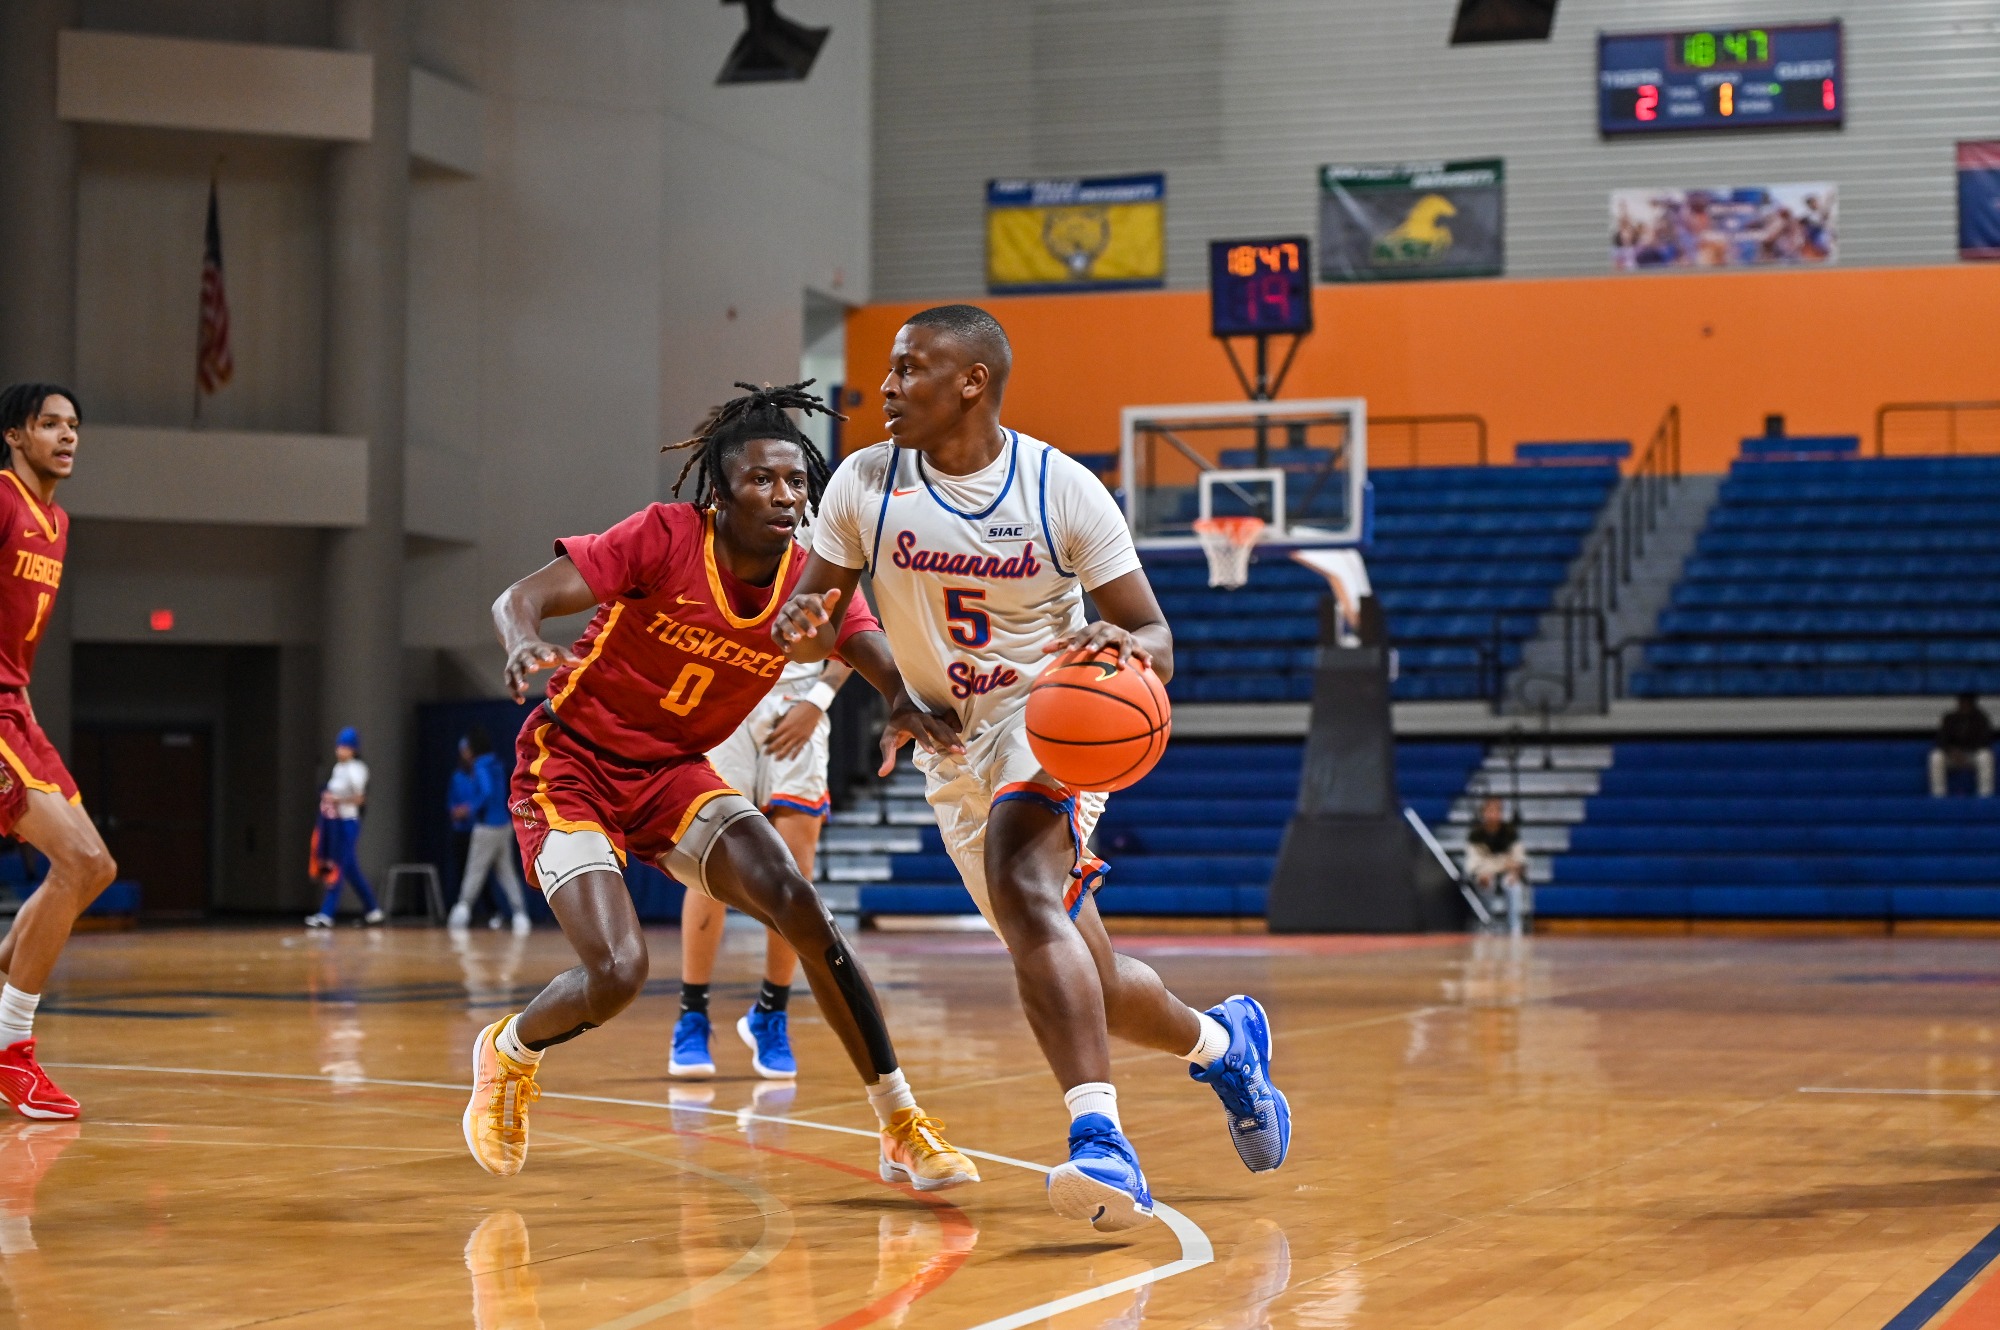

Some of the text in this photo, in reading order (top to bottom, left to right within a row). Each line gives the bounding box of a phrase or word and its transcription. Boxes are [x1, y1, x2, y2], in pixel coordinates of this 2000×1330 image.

[1635, 84, 1659, 121] 2
[1719, 82, 1733, 116] 1
[1822, 78, 1835, 110] 1
[988, 526, 1024, 538] SIAC
[892, 530, 1042, 580] Savannah
[943, 587, 992, 649] 5
[646, 611, 786, 678] TUSKEGEE
[659, 662, 715, 717] 0
[947, 662, 1019, 700] State
[834, 955, 844, 966] KT
